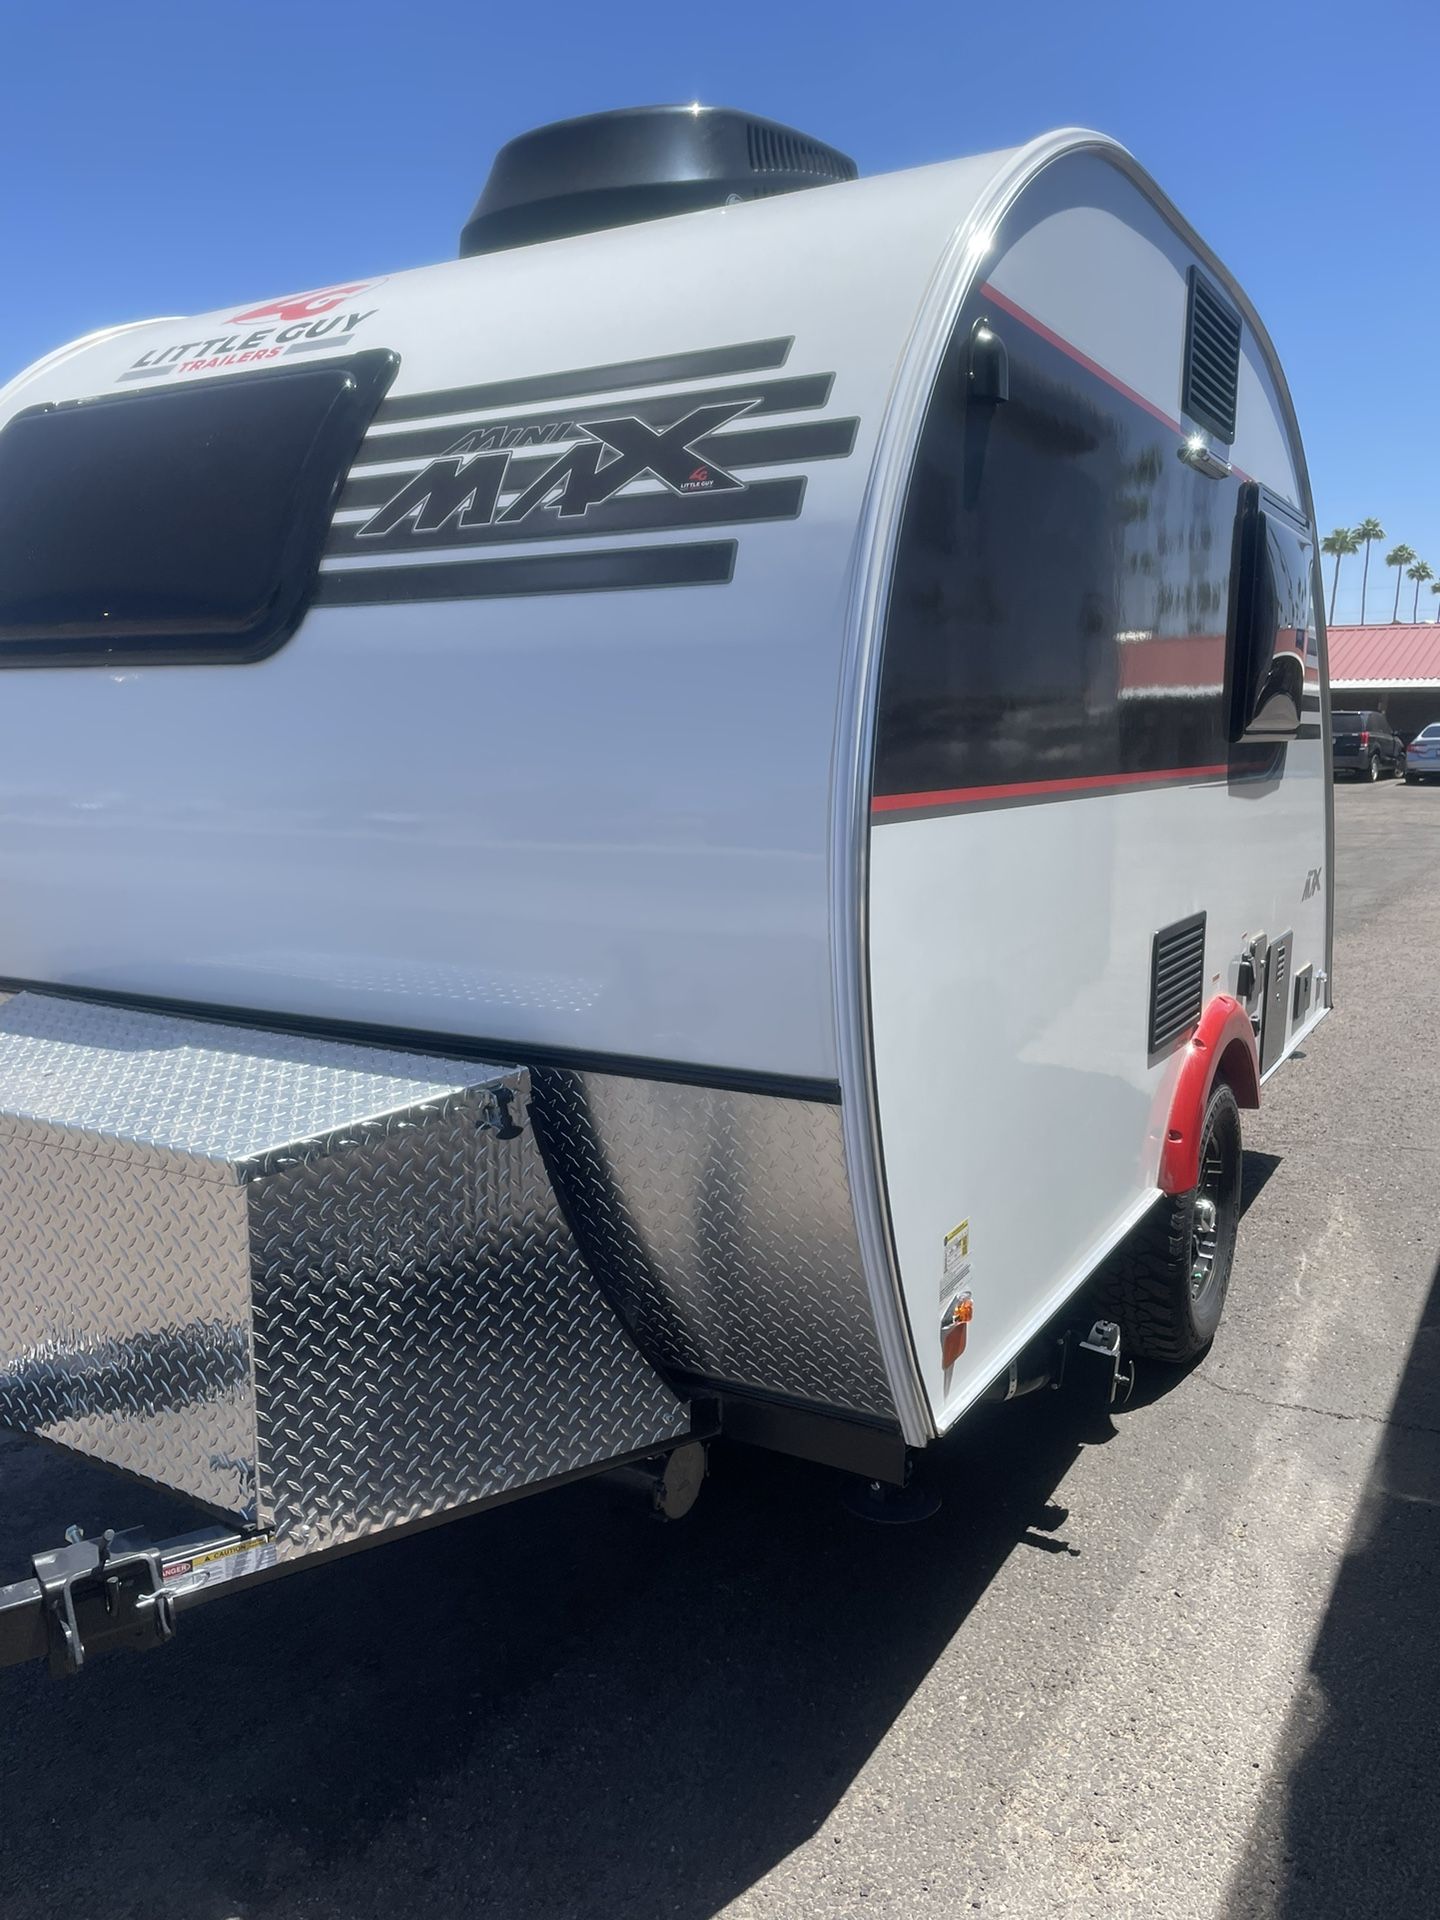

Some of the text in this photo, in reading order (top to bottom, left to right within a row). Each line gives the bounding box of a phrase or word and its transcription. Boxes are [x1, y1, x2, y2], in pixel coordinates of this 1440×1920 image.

[130, 309, 380, 369] LITTLE GUY
[178, 346, 282, 373] TRAILERS
[440, 421, 575, 455] MINI
[355, 398, 763, 538] MAX
[680, 481, 701, 489] LITTLE
[213, 1544, 246, 1558] CAUTION
[162, 1564, 188, 1576] ANGER
